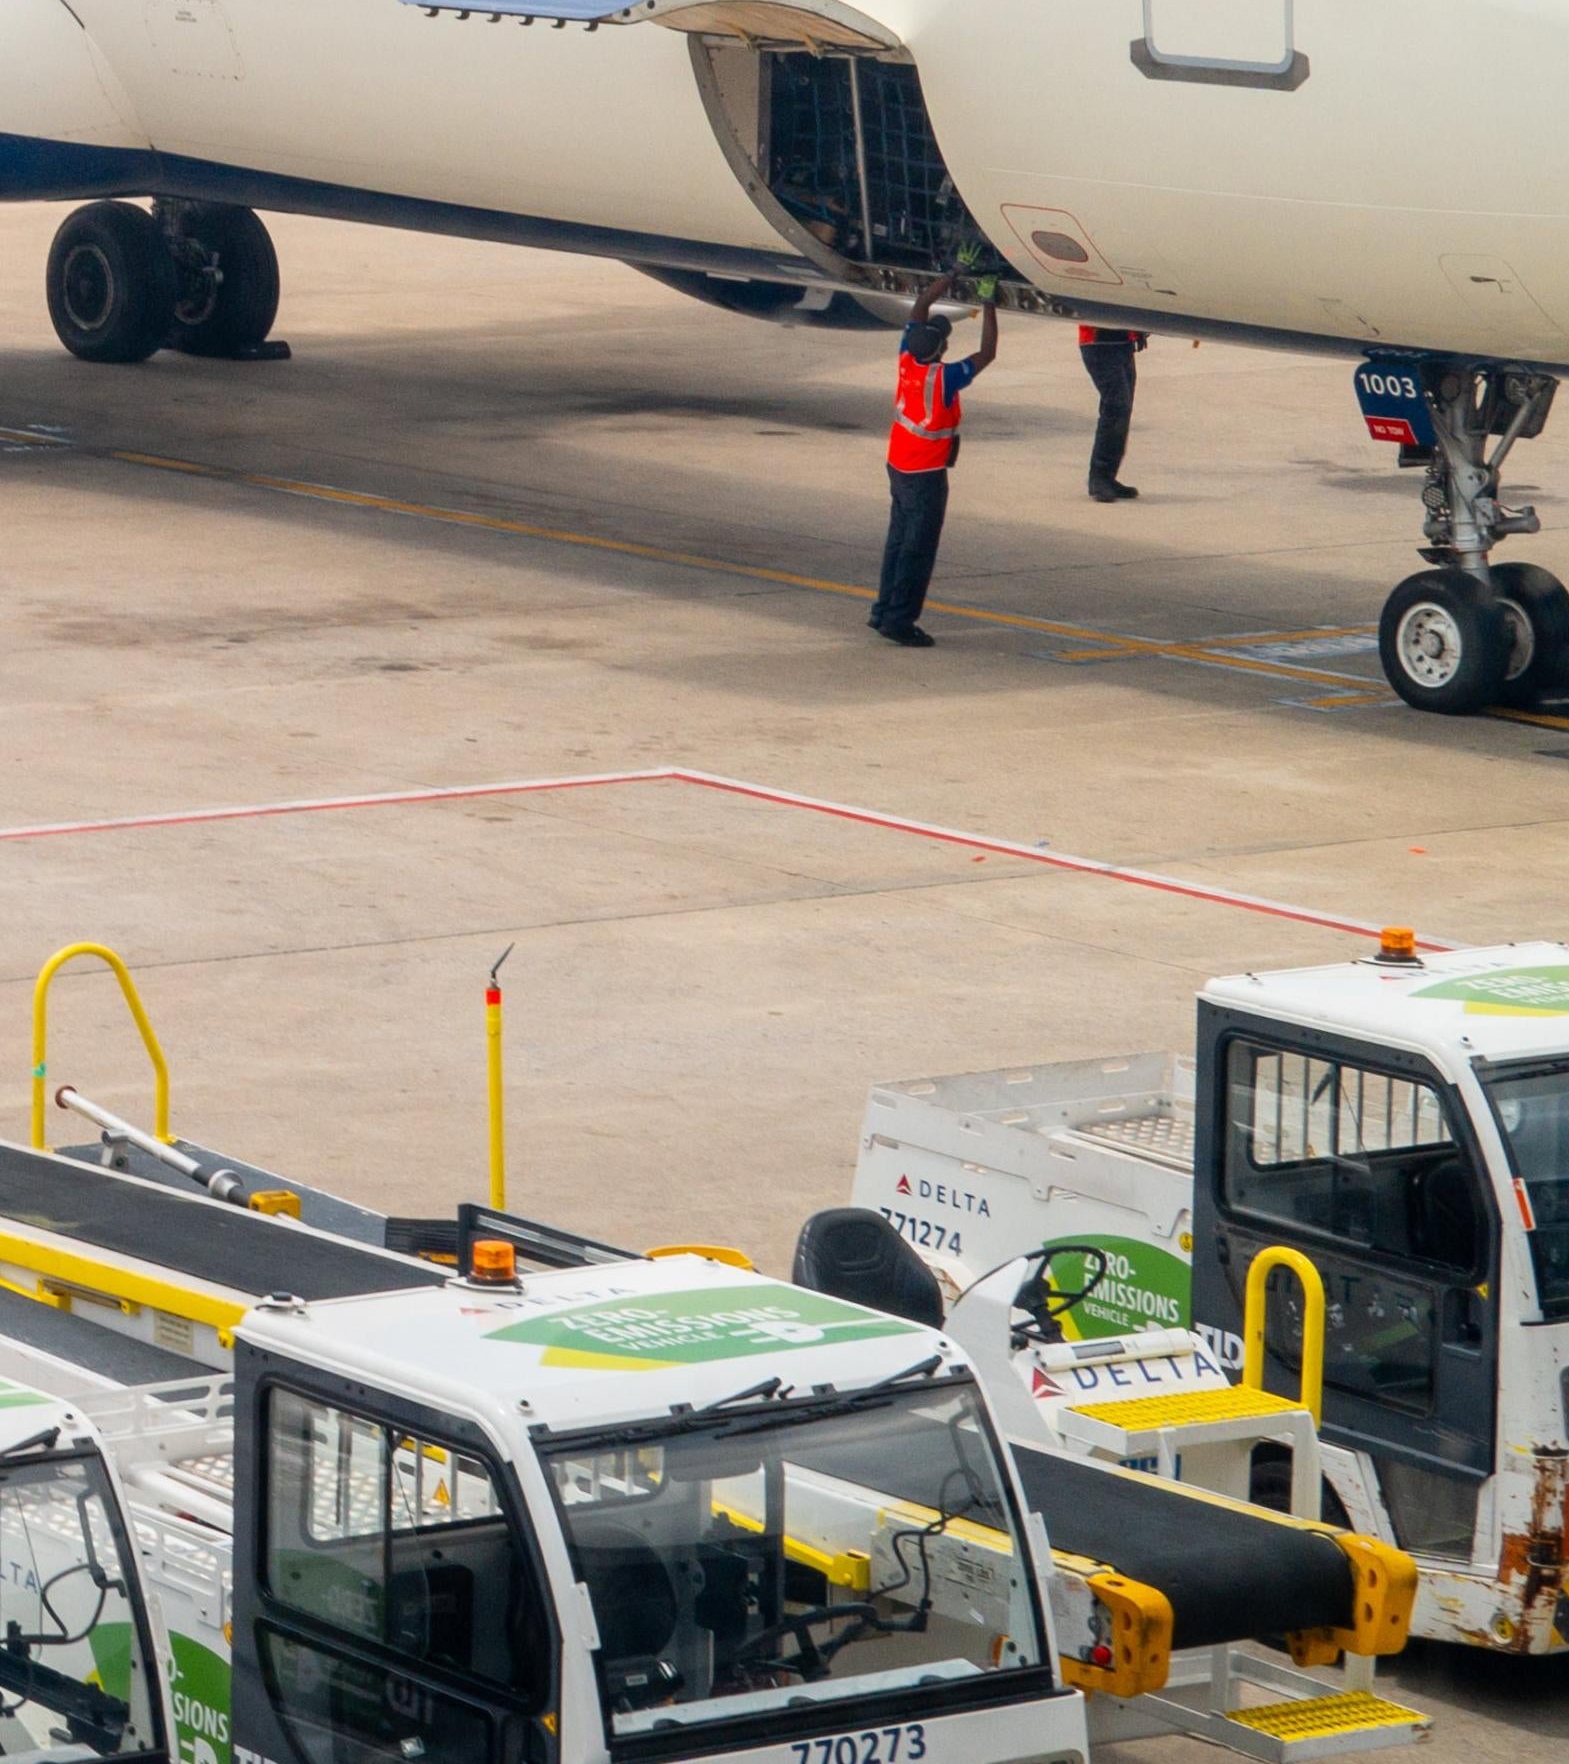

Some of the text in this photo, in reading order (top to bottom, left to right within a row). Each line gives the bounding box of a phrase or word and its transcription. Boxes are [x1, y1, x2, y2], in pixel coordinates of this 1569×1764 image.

[1359, 374, 1416, 398] 1003
[919, 1179, 990, 1218] DELTA
[494, 1286, 637, 1310] DELTA
[1084, 1301, 1129, 1327] VEHICLE
[548, 1306, 669, 1331] ZERO-
[582, 1306, 802, 1344] EMISSIONS
[617, 1329, 726, 1352] VEHICLE
[1071, 1351, 1220, 1390] DELTA
[172, 1691, 229, 1743] SIONS
[790, 1723, 926, 1764] 770273
